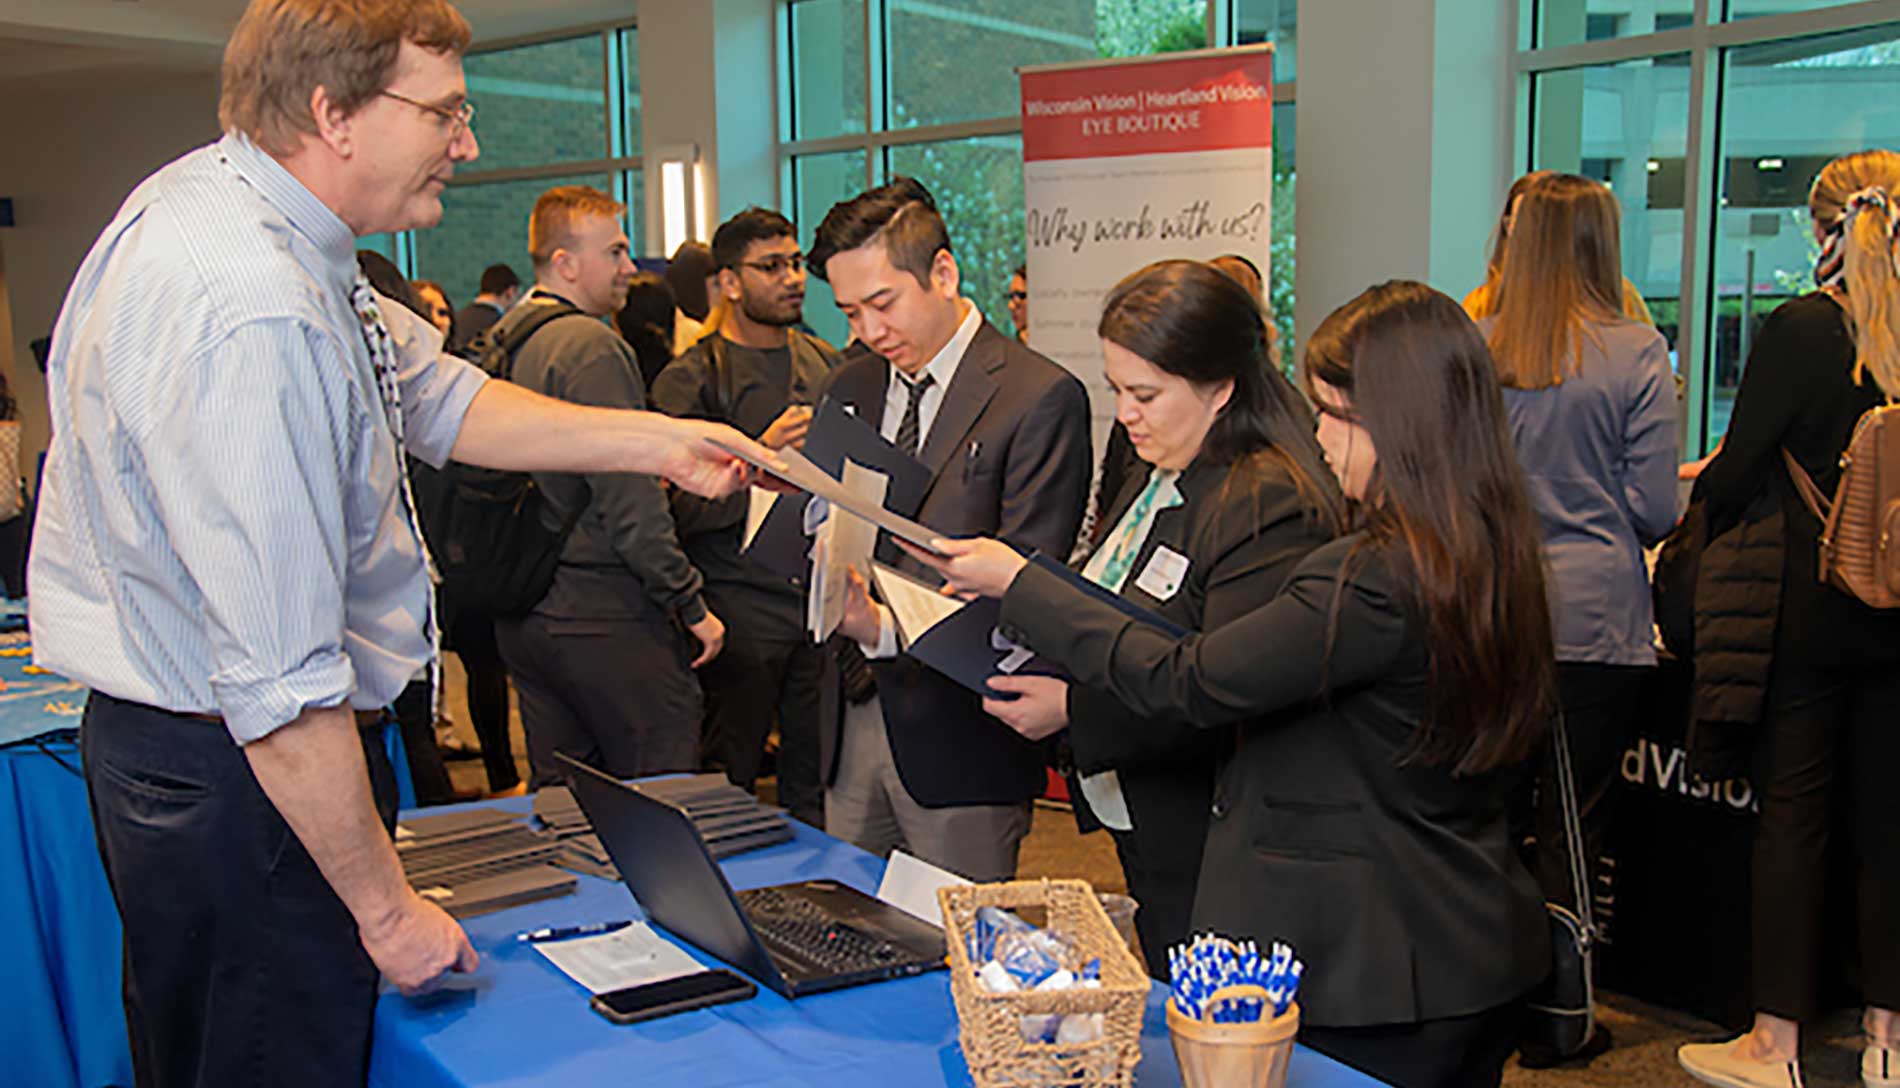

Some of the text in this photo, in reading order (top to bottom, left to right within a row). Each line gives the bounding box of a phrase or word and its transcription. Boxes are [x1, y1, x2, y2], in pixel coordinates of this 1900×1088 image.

[1026, 98, 1091, 116] Wisconsin
[1092, 95, 1136, 112] Vision
[1146, 88, 1216, 108] Heartland
[1217, 84, 1266, 102] Vision
[1082, 110, 1201, 136] EYE BOUTIQUE
[1028, 200, 1265, 253] Why work with us?
[1620, 738, 1760, 813] dVisio
